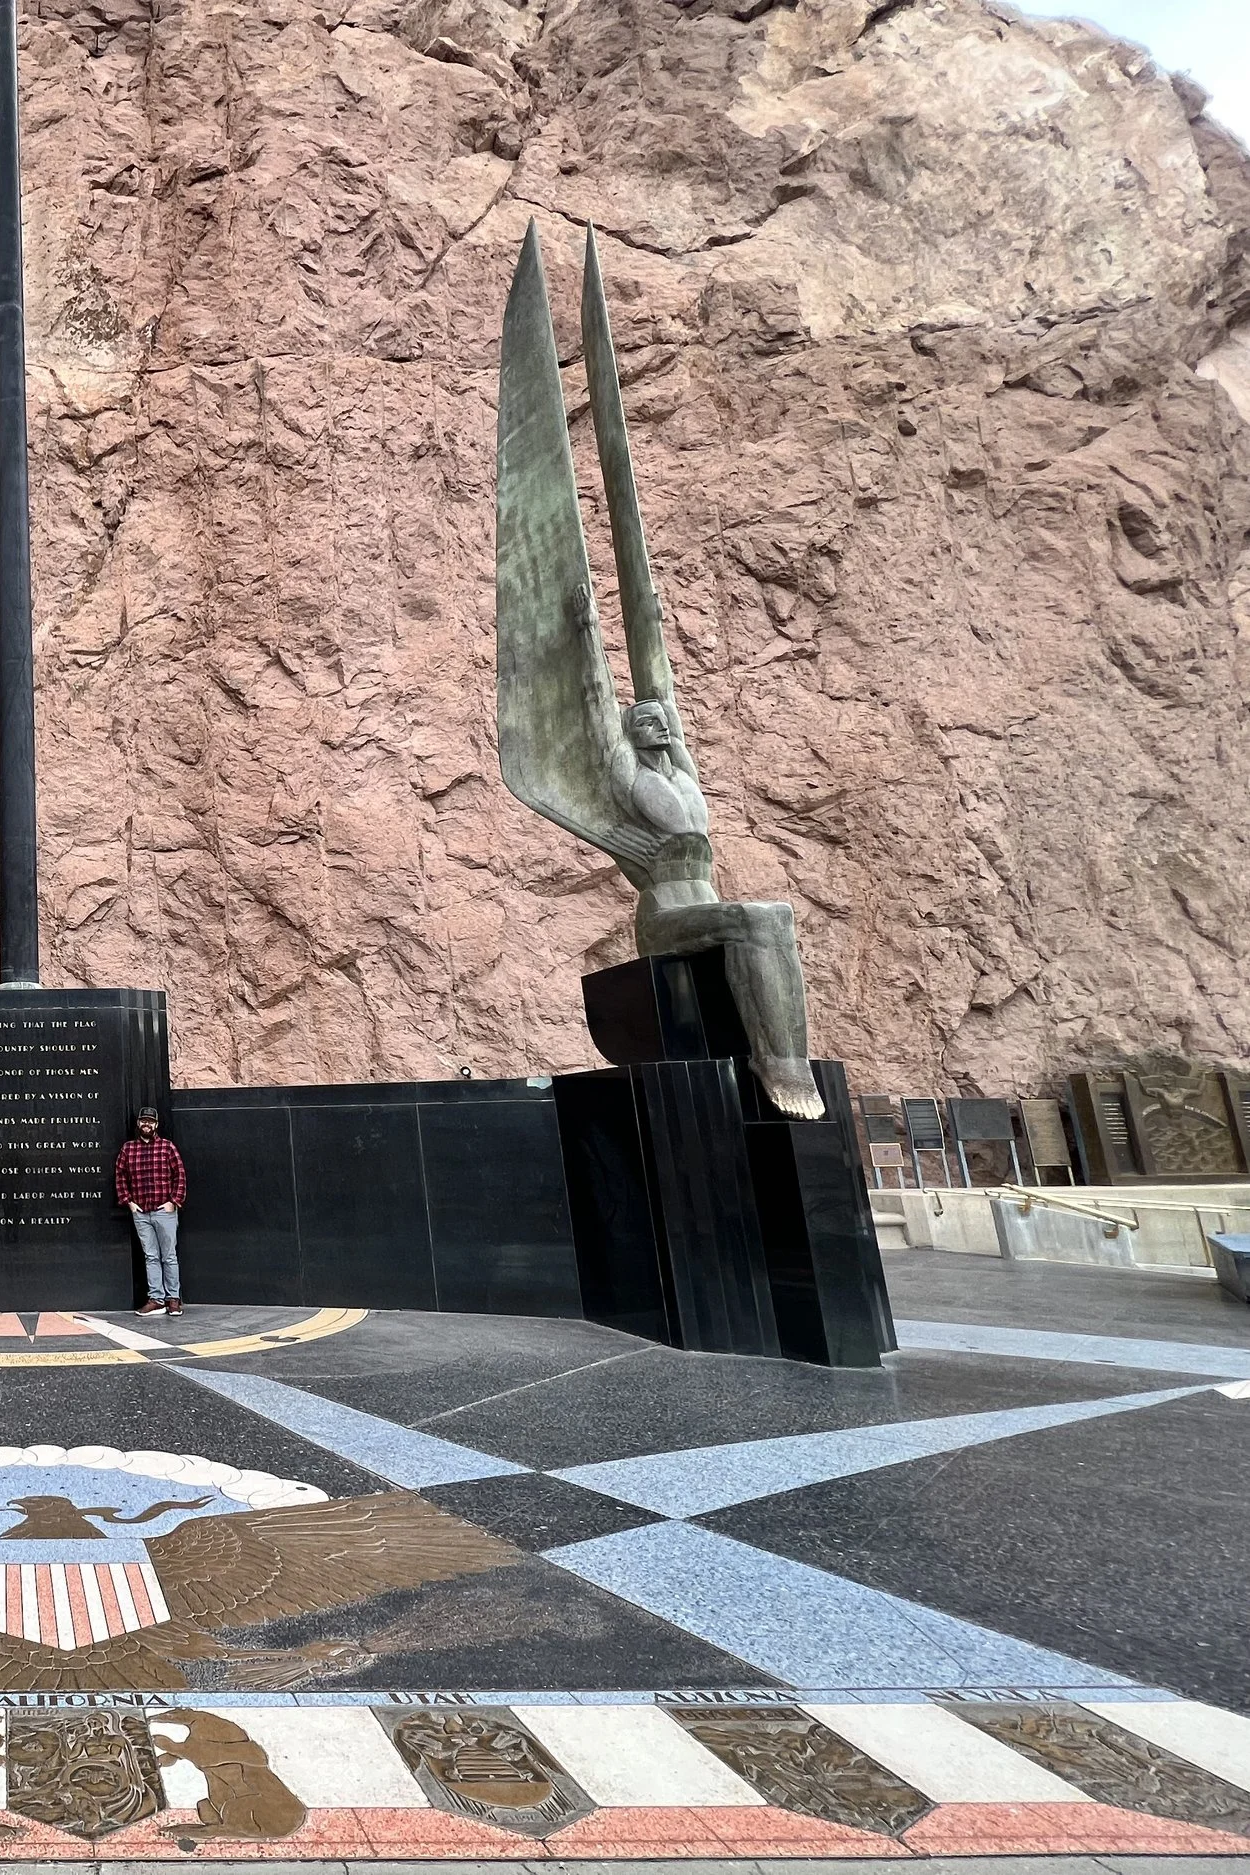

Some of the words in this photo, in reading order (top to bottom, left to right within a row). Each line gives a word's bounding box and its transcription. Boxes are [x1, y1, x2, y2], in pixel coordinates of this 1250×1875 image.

[23, 1020, 45, 1029] THAT
[51, 1020, 67, 1029] THE
[74, 1020, 97, 1028] FLAG
[40, 1044, 76, 1053] SHOULD
[29, 1068, 41, 1076] OF
[46, 1068, 75, 1076] THOSE
[80, 1068, 99, 1076] MEN
[25, 1093, 36, 1101] BY
[49, 1092, 83, 1100] VISION
[88, 1092, 99, 1100] OF
[21, 1117, 46, 1125] MADE
[8, 1141, 29, 1150] THIS
[36, 1141, 67, 1150] GREAT
[73, 1141, 100, 1149] WORK
[25, 1166, 63, 1175] OTHERS
[69, 1165, 102, 1174] WHOSE
[14, 1191, 45, 1200] LABOR
[51, 1191, 75, 1199] MADE
[80, 1191, 102, 1199] THAT
[31, 1216, 71, 1225] REALITY
[389, 1692, 478, 1704] UTAH
[654, 1691, 801, 1703] ARIZONA
[920, 1689, 1070, 1701] NEVADA
